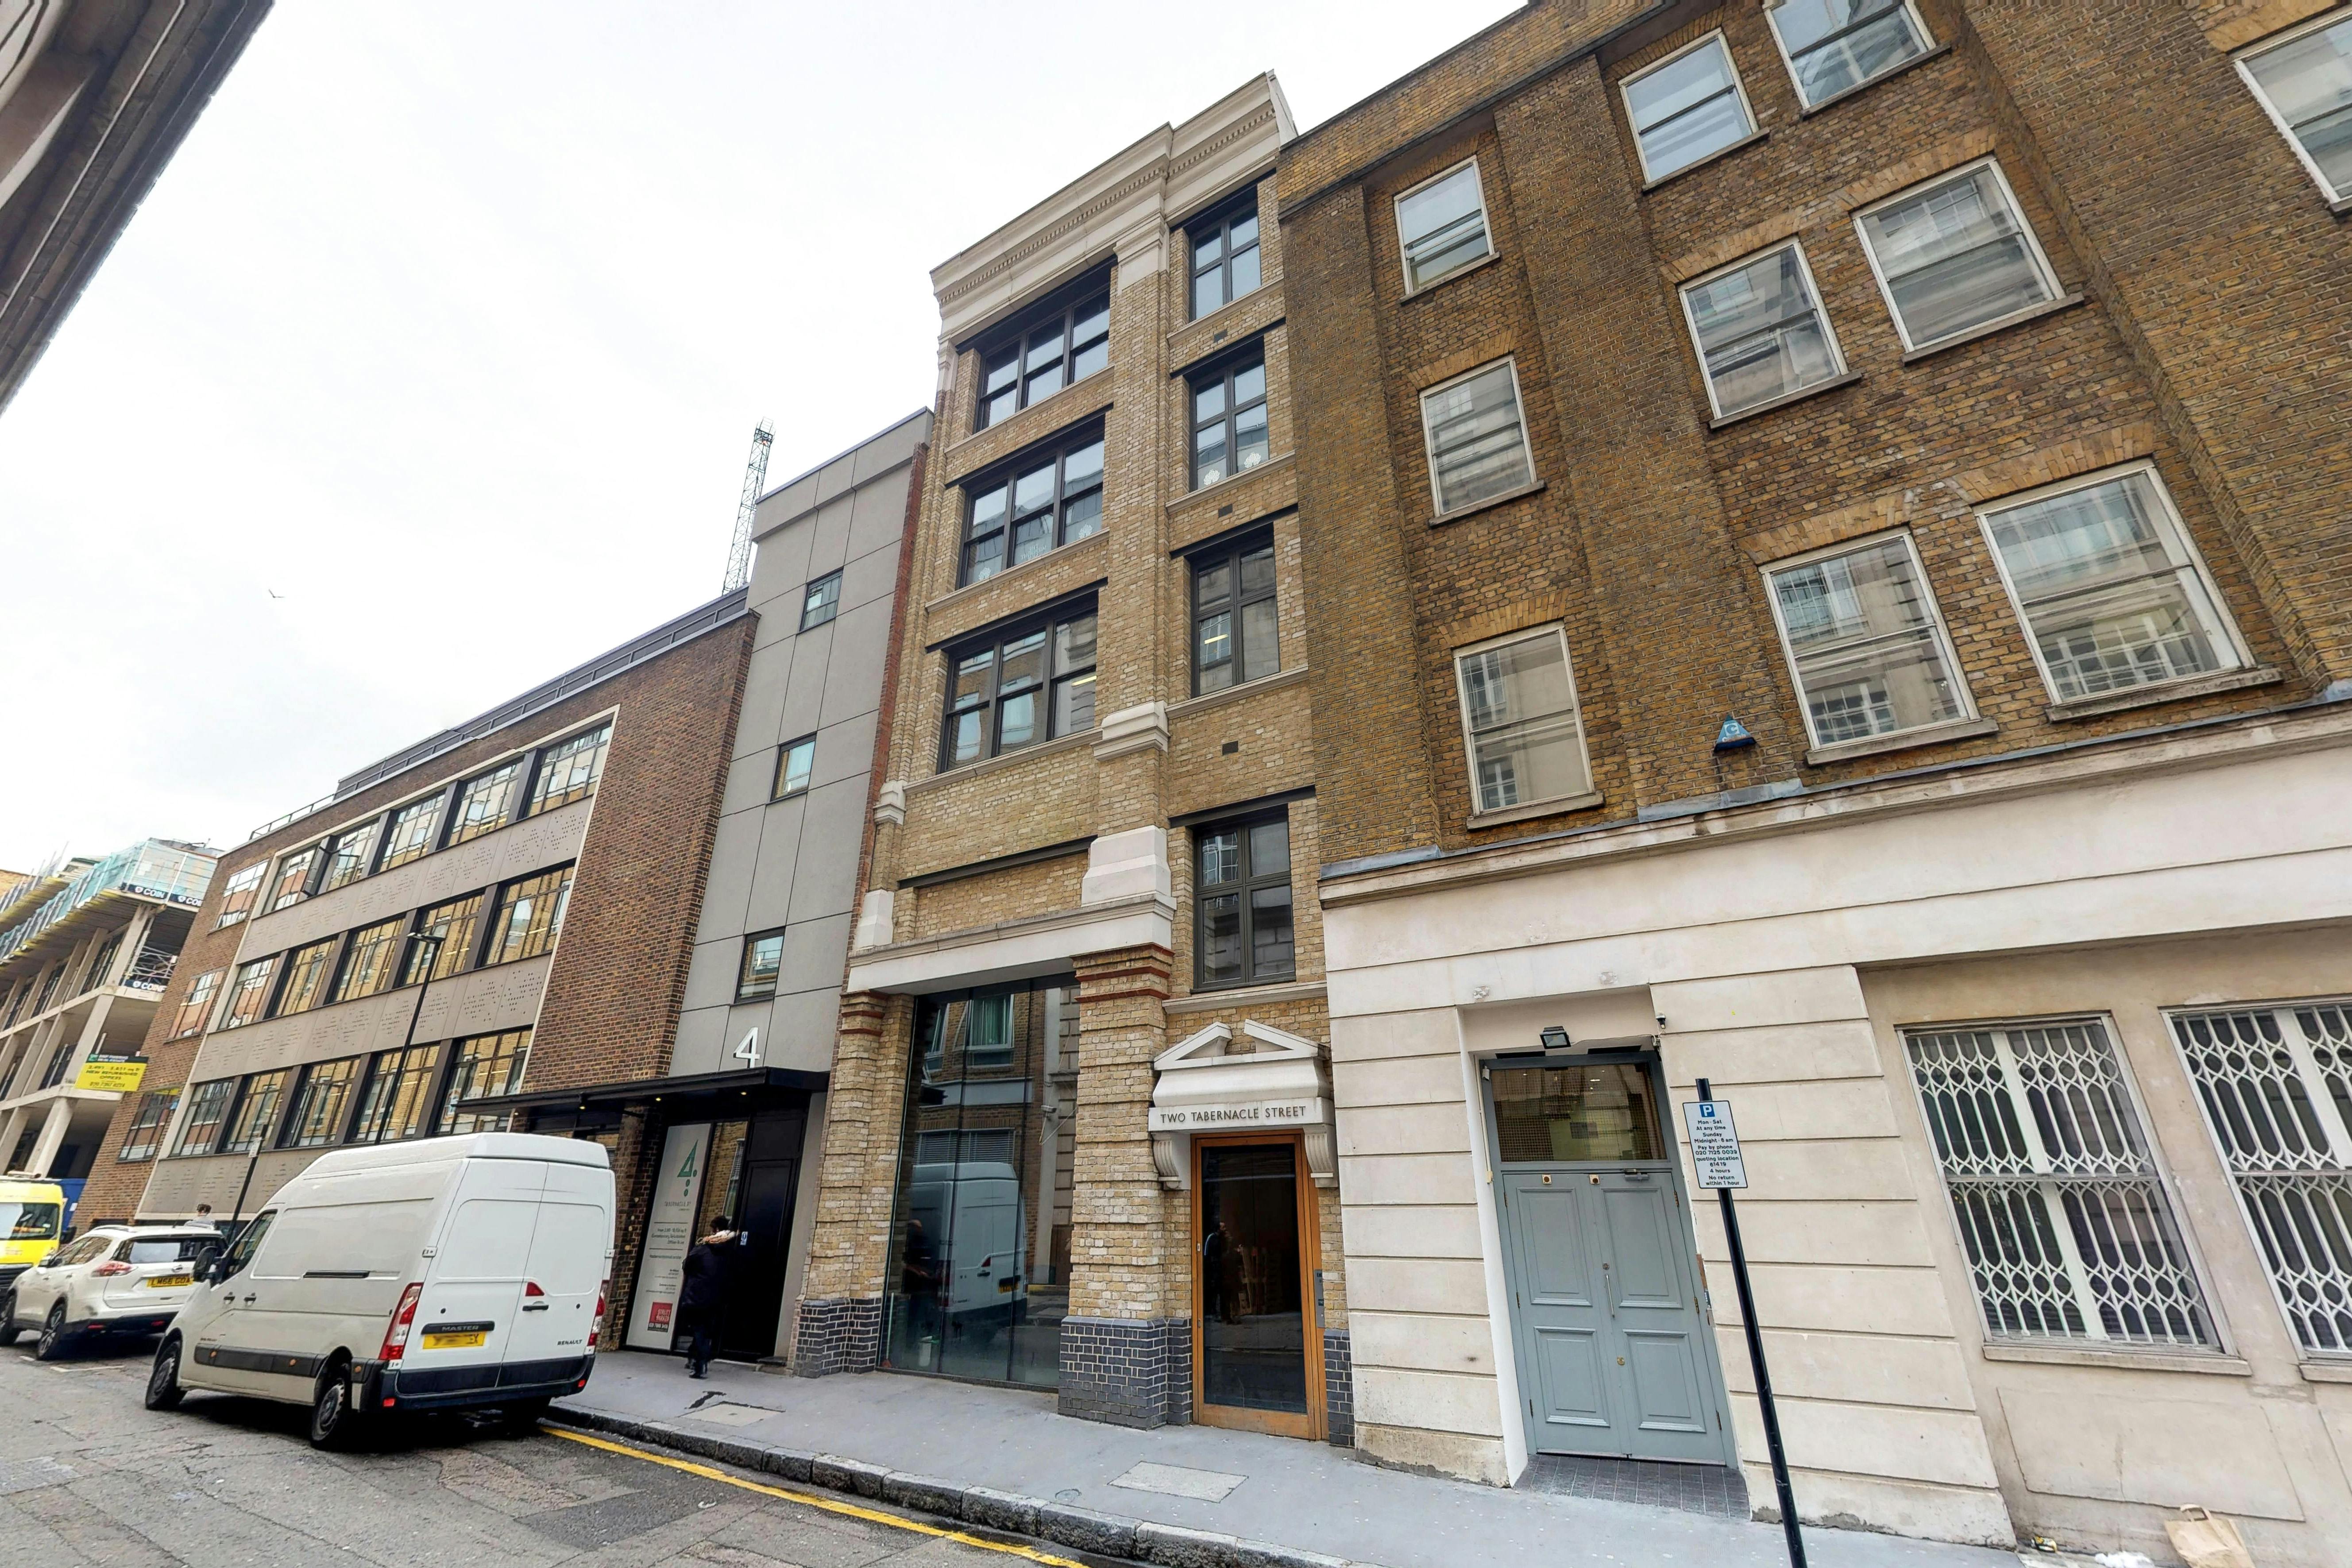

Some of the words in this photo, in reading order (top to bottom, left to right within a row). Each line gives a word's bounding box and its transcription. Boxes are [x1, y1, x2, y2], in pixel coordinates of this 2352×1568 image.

[733, 1027, 760, 1068] 4
[1160, 1112, 1186, 1123] TWO
[1191, 1108, 1259, 1121] TABERNACLE
[1265, 1106, 1306, 1118] STREET
[1703, 1105, 1712, 1116] P
